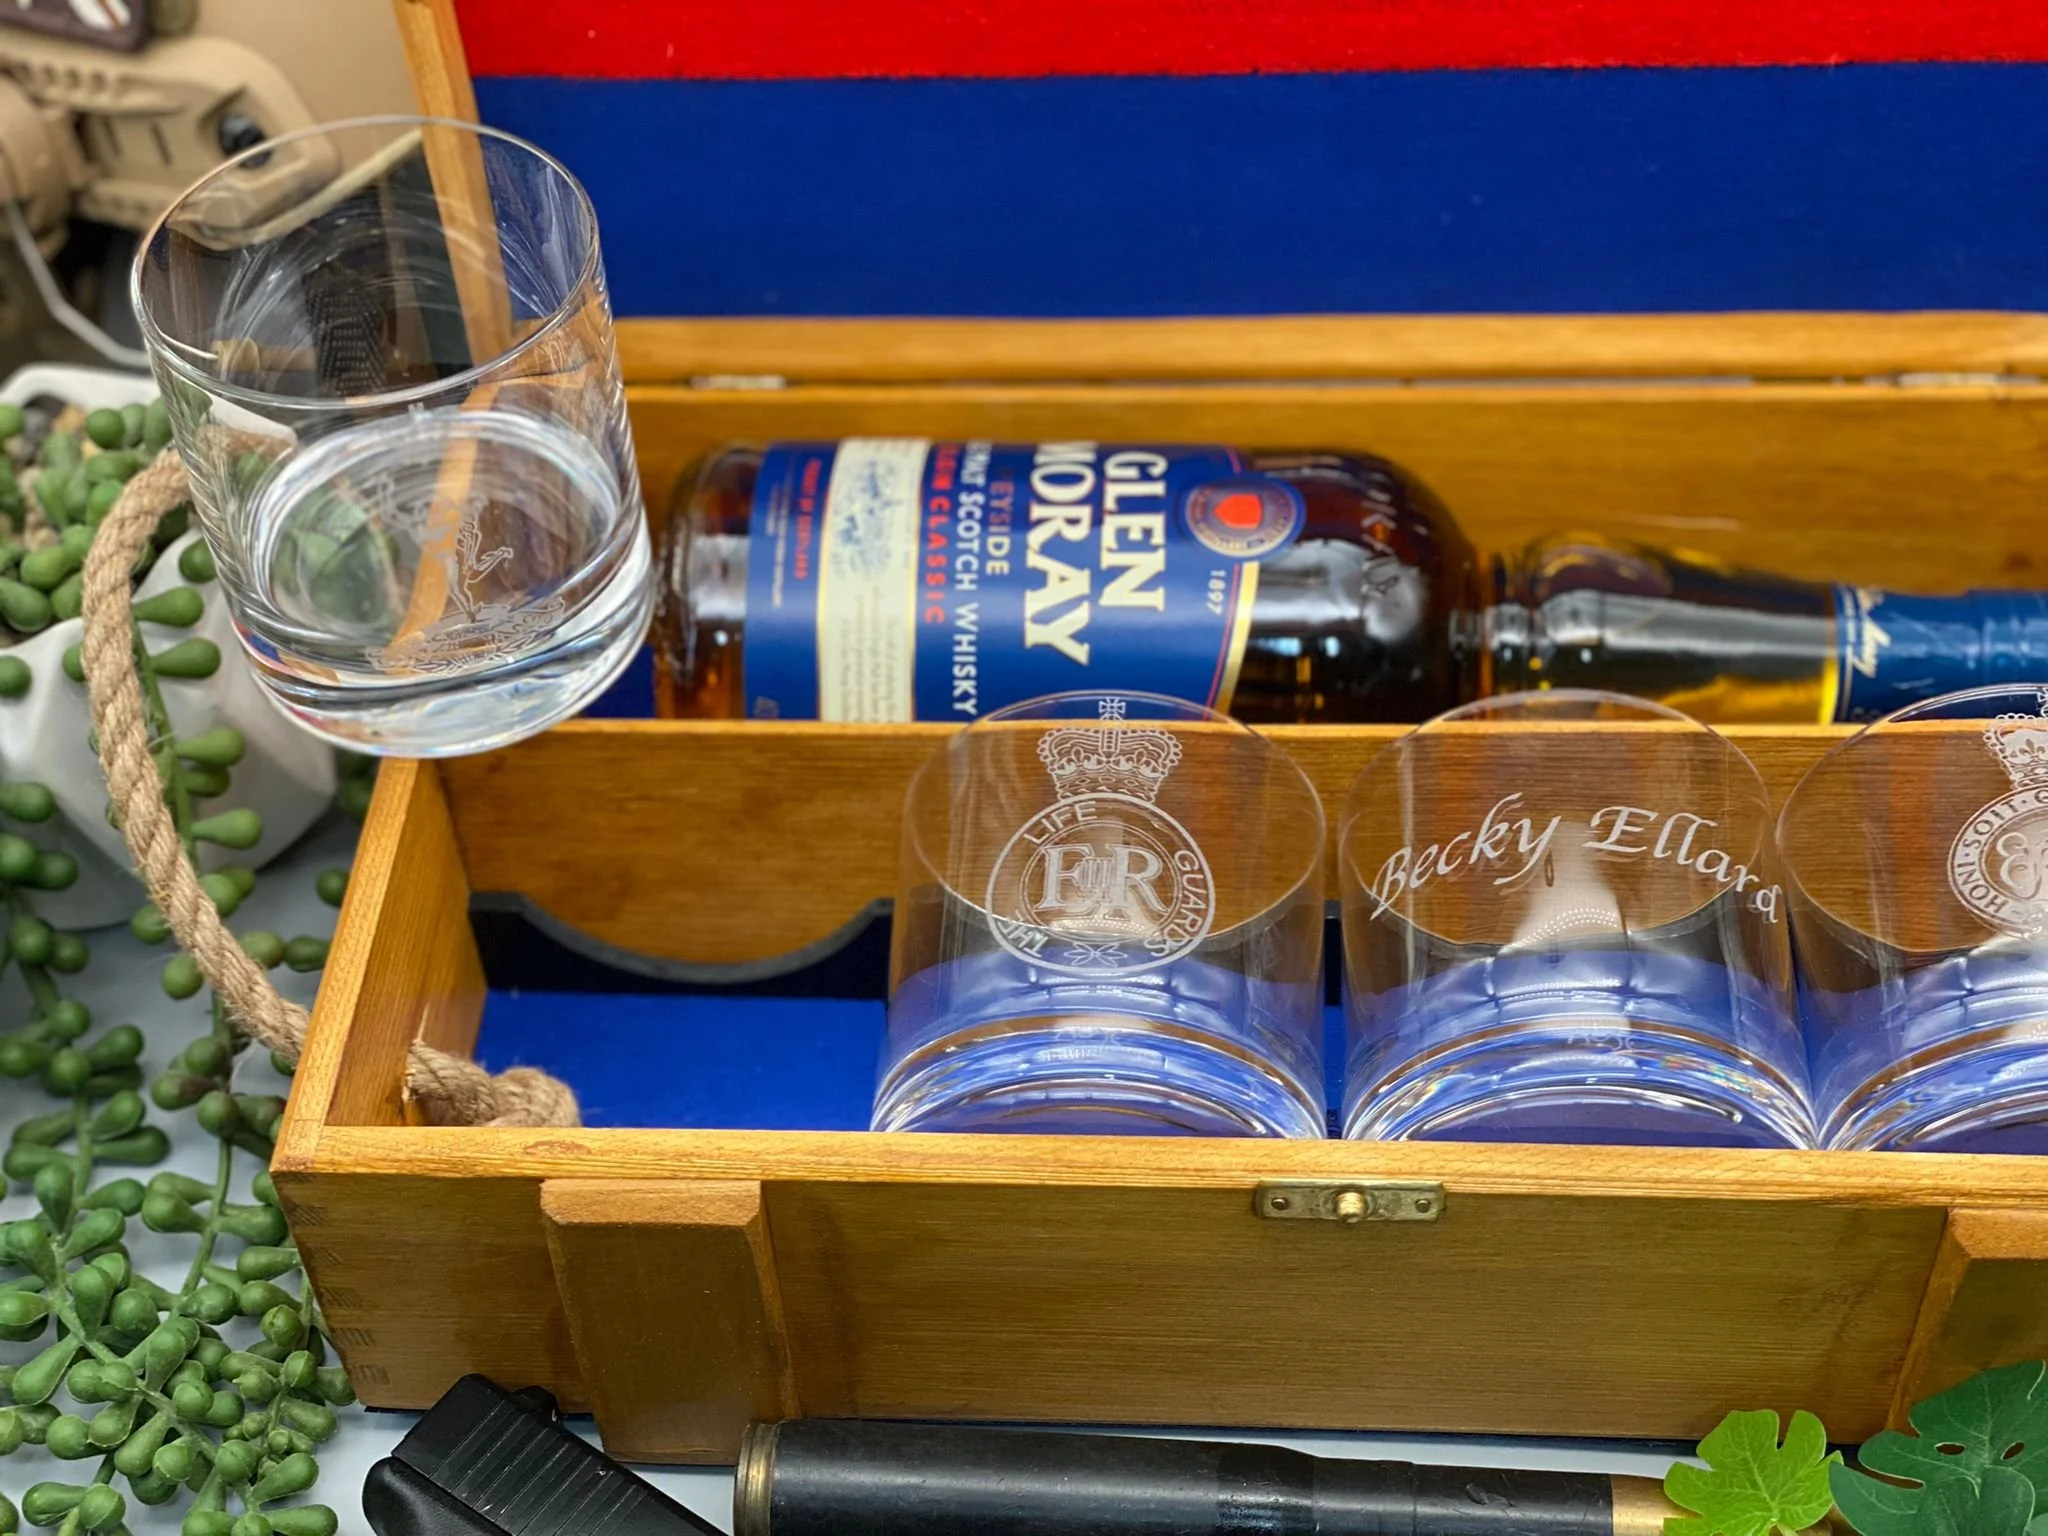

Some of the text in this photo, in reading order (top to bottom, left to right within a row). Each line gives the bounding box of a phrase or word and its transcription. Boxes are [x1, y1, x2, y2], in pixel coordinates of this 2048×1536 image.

[924, 496, 951, 624] CLASSIC
[955, 491, 985, 591] SCOTCH
[1099, 450, 1168, 612] GLEN
[1207, 568, 1227, 616] 1897
[952, 602, 979, 716] WHISKY
[1023, 799, 1099, 846] LIFE
[1143, 849, 1208, 959] GUARDS
[1370, 792, 1562, 921] Becky
[1957, 798, 2020, 914] HONI SOIT
